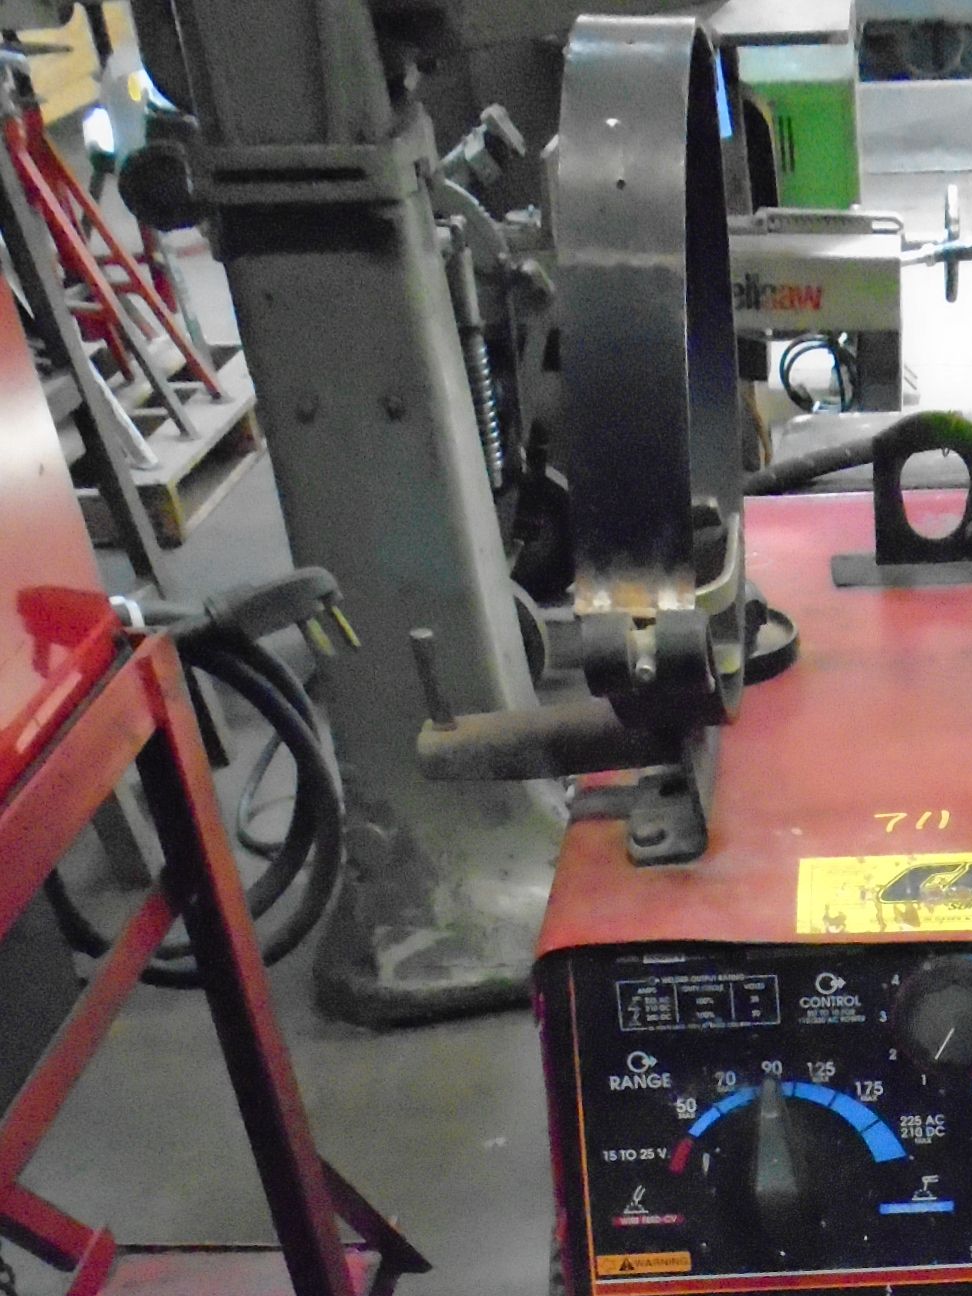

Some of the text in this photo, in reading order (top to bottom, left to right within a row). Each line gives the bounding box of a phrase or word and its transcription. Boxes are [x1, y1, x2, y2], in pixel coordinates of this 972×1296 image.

[891, 973, 900, 986] 4
[799, 995, 862, 1009] CONTROL
[879, 1010, 888, 1022] 3
[889, 1048, 897, 1061] 2
[761, 1060, 783, 1076] 90
[807, 1061, 836, 1077] 125
[609, 1072, 672, 1091] RANGE
[921, 1073, 927, 1085] 1
[855, 1081, 884, 1096] 175
[676, 1098, 697, 1113] 50
[900, 1114, 945, 1128] 225 AC
[926, 1125, 945, 1137] DC
[603, 1148, 667, 1162] 15 TO 25 V
[636, 1256, 689, 1267] WARNING
